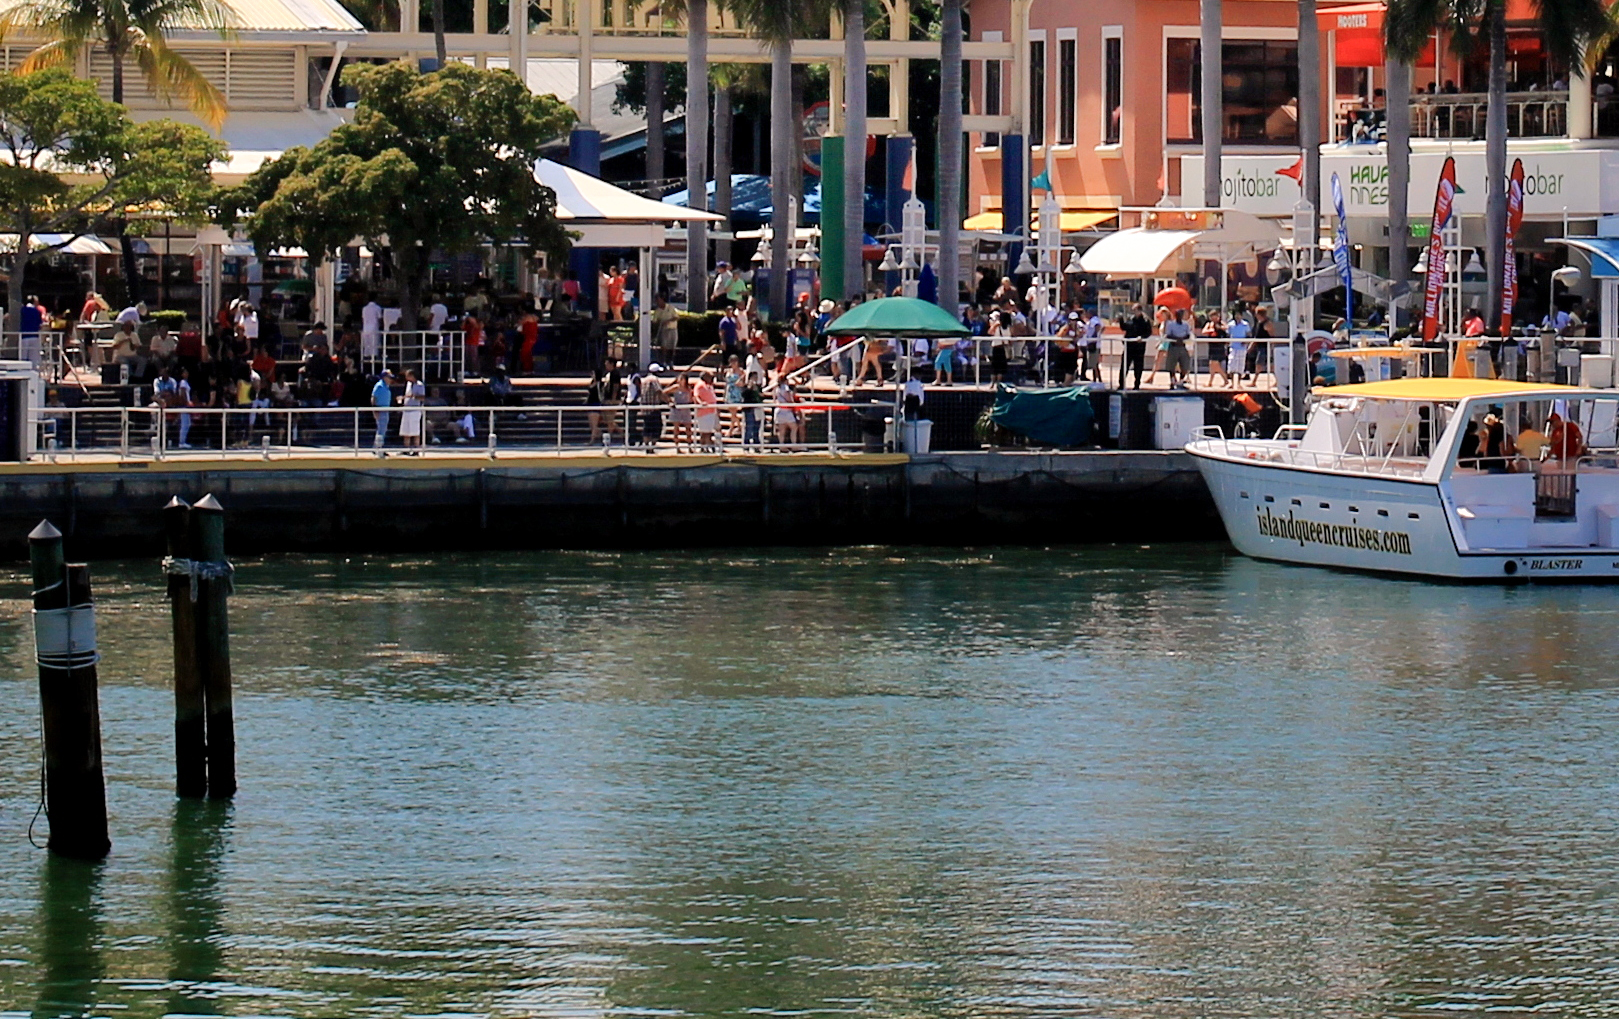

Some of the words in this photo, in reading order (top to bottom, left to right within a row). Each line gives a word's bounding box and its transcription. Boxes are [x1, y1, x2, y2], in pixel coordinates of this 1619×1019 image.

[1338, 14, 1367, 28] HOOTERS
[1220, 167, 1280, 204] ojitobar
[1256, 505, 1412, 555] islandqueencruises.com
[1530, 559, 1583, 570] BLASTER
